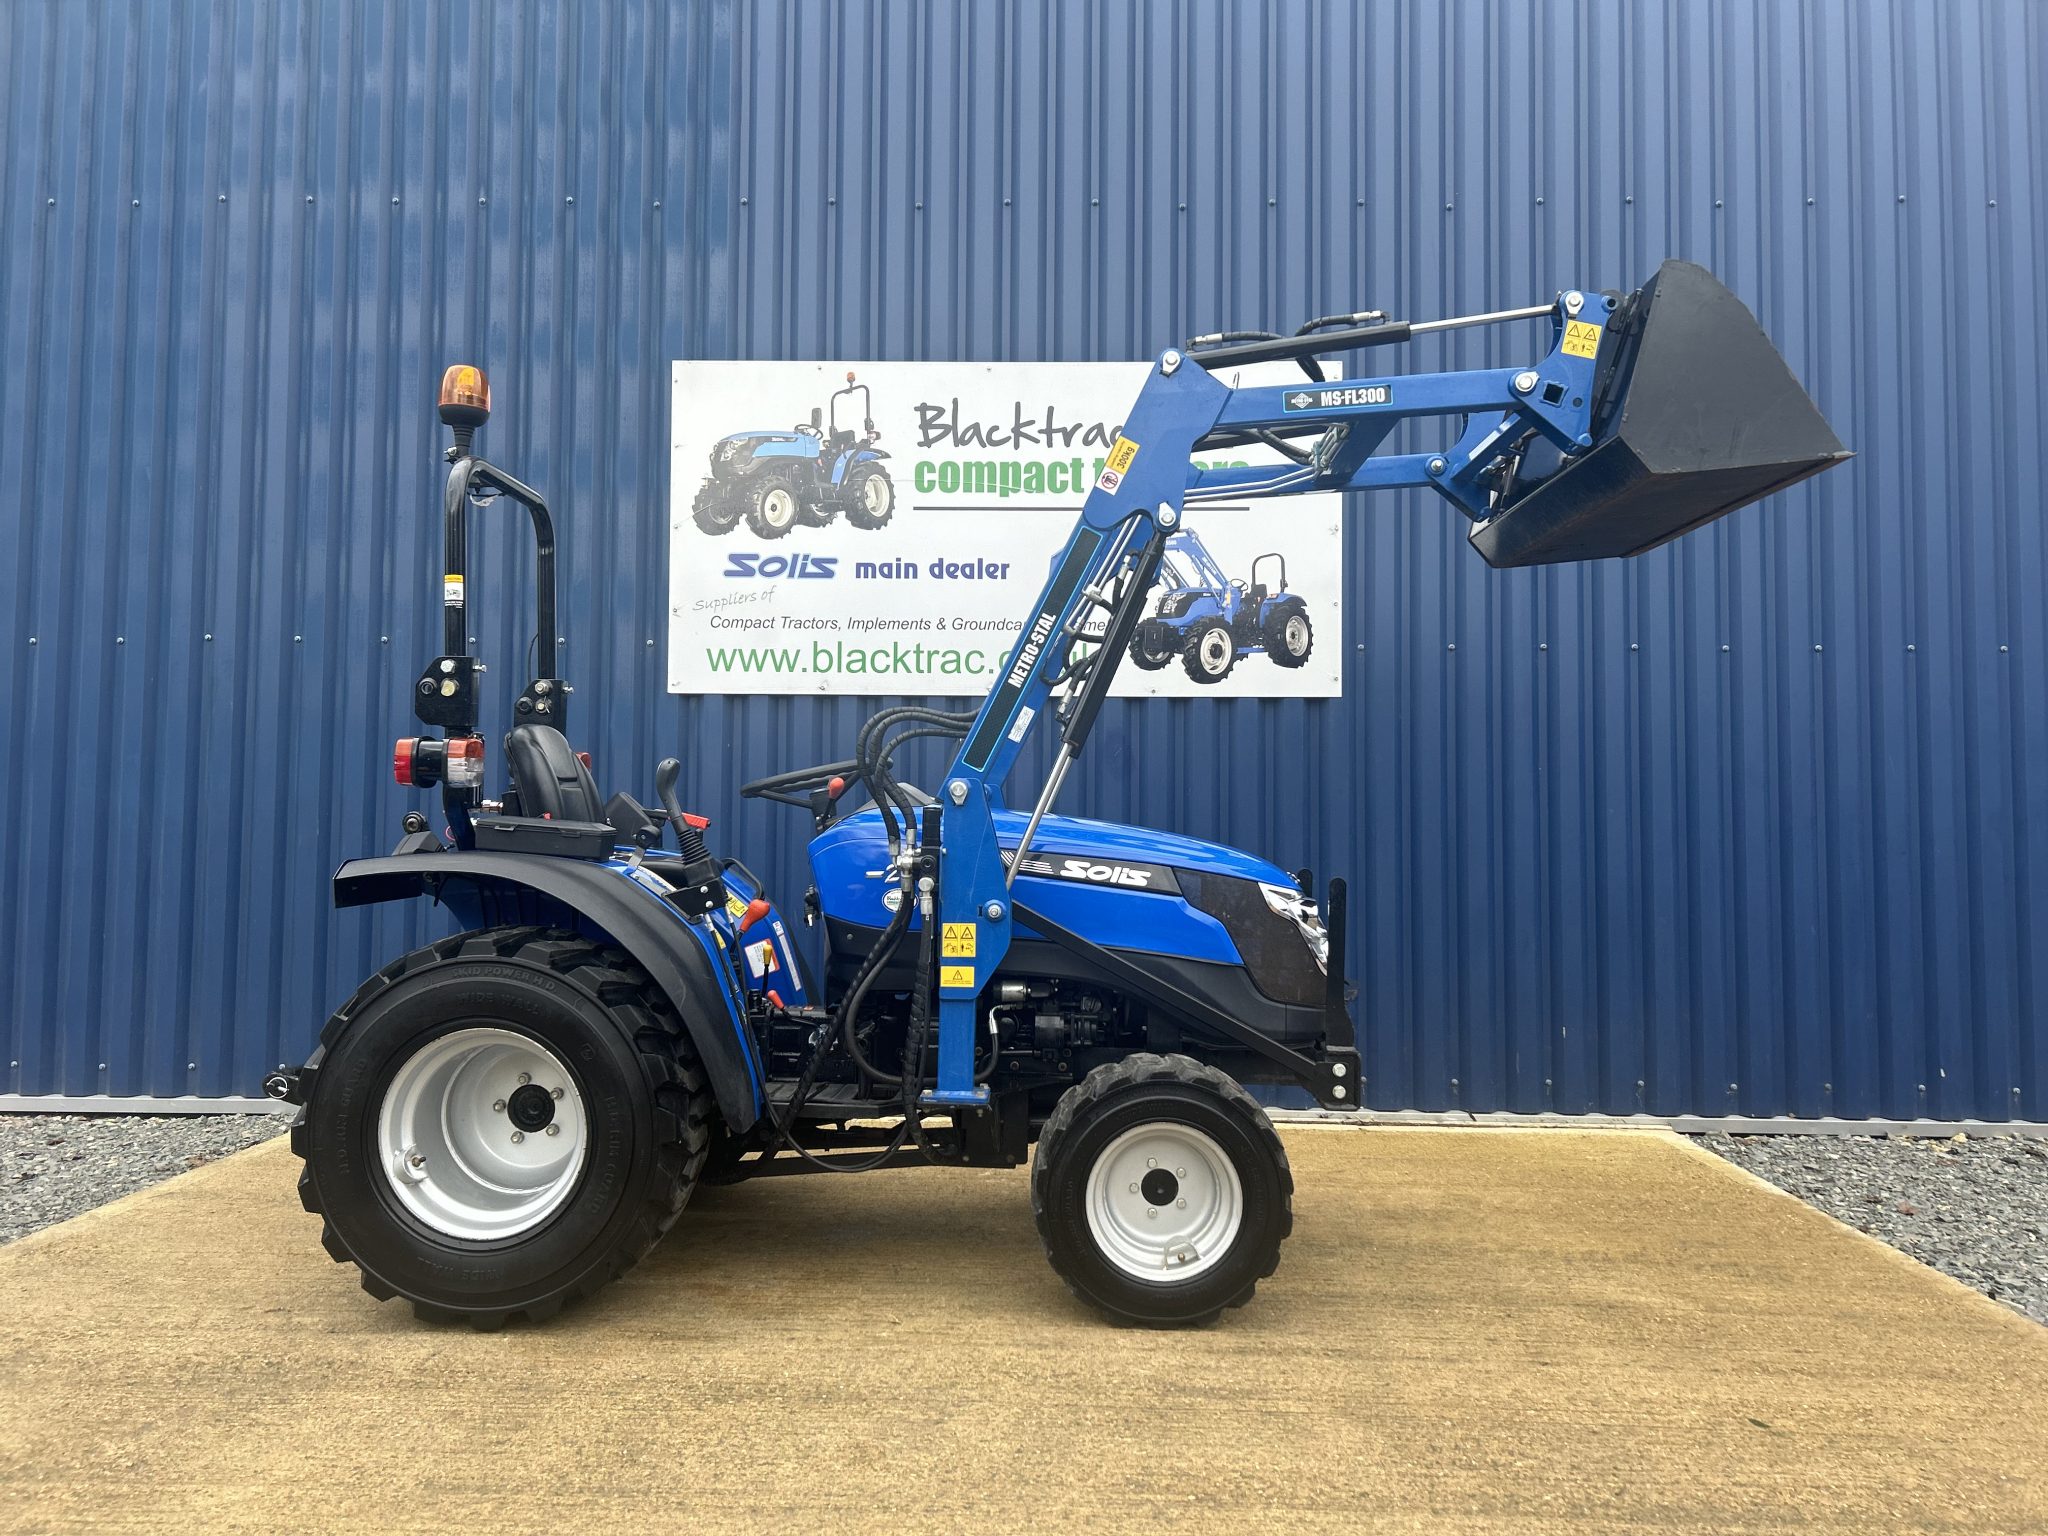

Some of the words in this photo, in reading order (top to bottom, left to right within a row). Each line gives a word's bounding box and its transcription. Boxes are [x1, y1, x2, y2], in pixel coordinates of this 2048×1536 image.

[1321, 387, 1386, 406] MS-FL300
[1117, 446, 1135, 469] 300kg
[914, 458, 1085, 497] compact
[723, 553, 838, 579] Solis
[855, 558, 918, 579] main
[929, 558, 1010, 579] dealer
[692, 592, 757, 612] Suppliers
[761, 586, 777, 604] of
[710, 615, 775, 630] Compact
[781, 616, 842, 631] Tractors,
[847, 617, 931, 631] Implements
[936, 618, 947, 630] &
[1007, 612, 1056, 689] METRO-STAL
[1060, 860, 1151, 887] Solis
[452, 966, 481, 978] SKID
[484, 966, 530, 980] POWER
